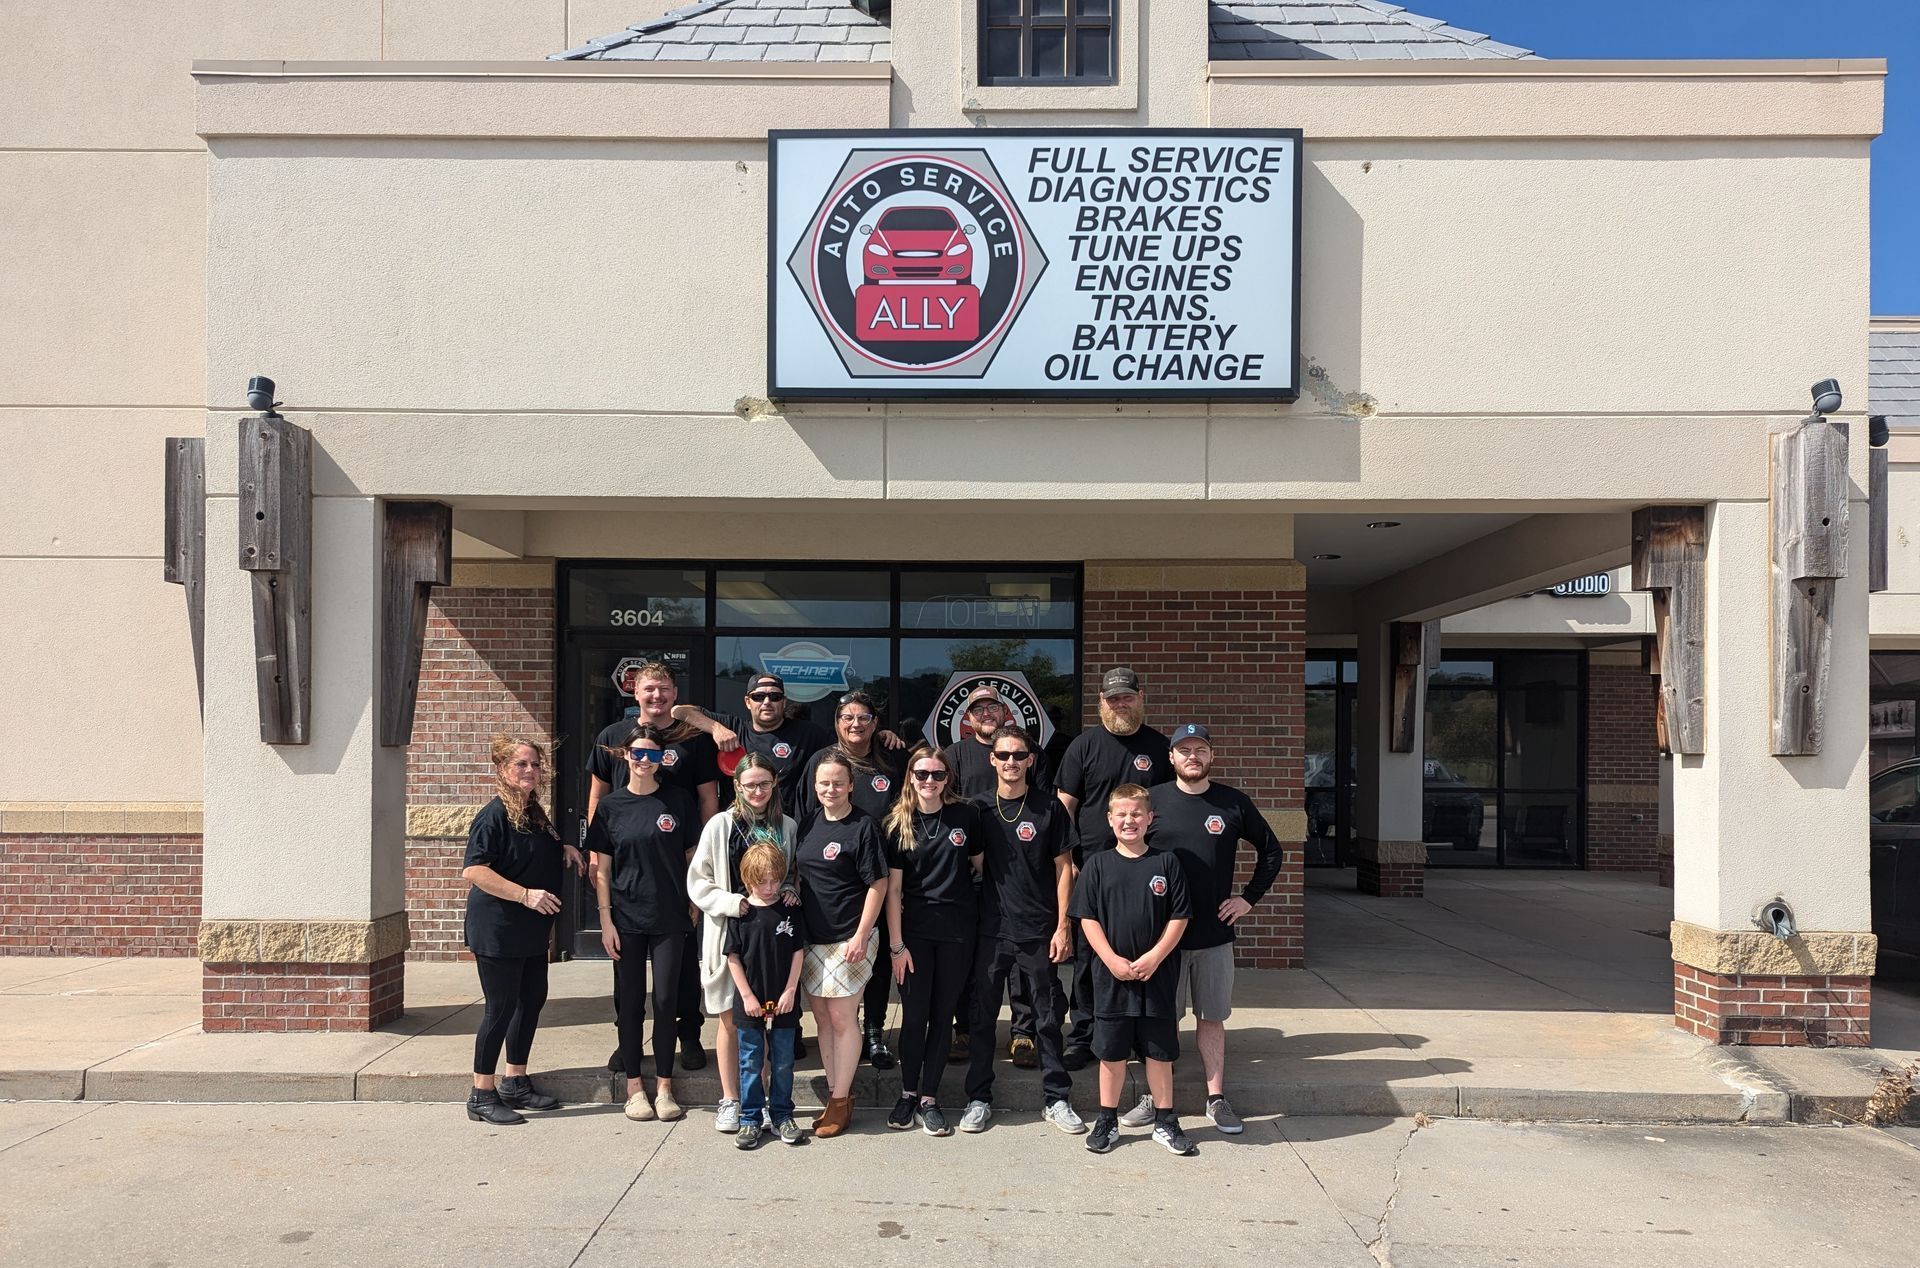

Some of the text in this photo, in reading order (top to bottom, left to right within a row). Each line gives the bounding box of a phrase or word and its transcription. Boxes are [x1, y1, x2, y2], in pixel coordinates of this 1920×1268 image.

[1028, 147, 1282, 173] FULL SERVICE
[1028, 176, 1271, 202] DIAGNOSTICS
[824, 167, 1013, 258] AUTO SERVICE
[1076, 206, 1223, 232] BRAKES
[1069, 235, 1242, 261] TUNE UPS
[1075, 265, 1232, 291] ENGINES
[868, 296, 966, 329] ALLY
[1092, 295, 1215, 321] TRANS.
[1072, 325, 1237, 350] BATTERY
[1045, 354, 1264, 380] OIL CHANGE
[610, 609, 664, 626] 3604
[950, 599, 1036, 626] OPEN
[940, 687, 969, 728] AUTO
